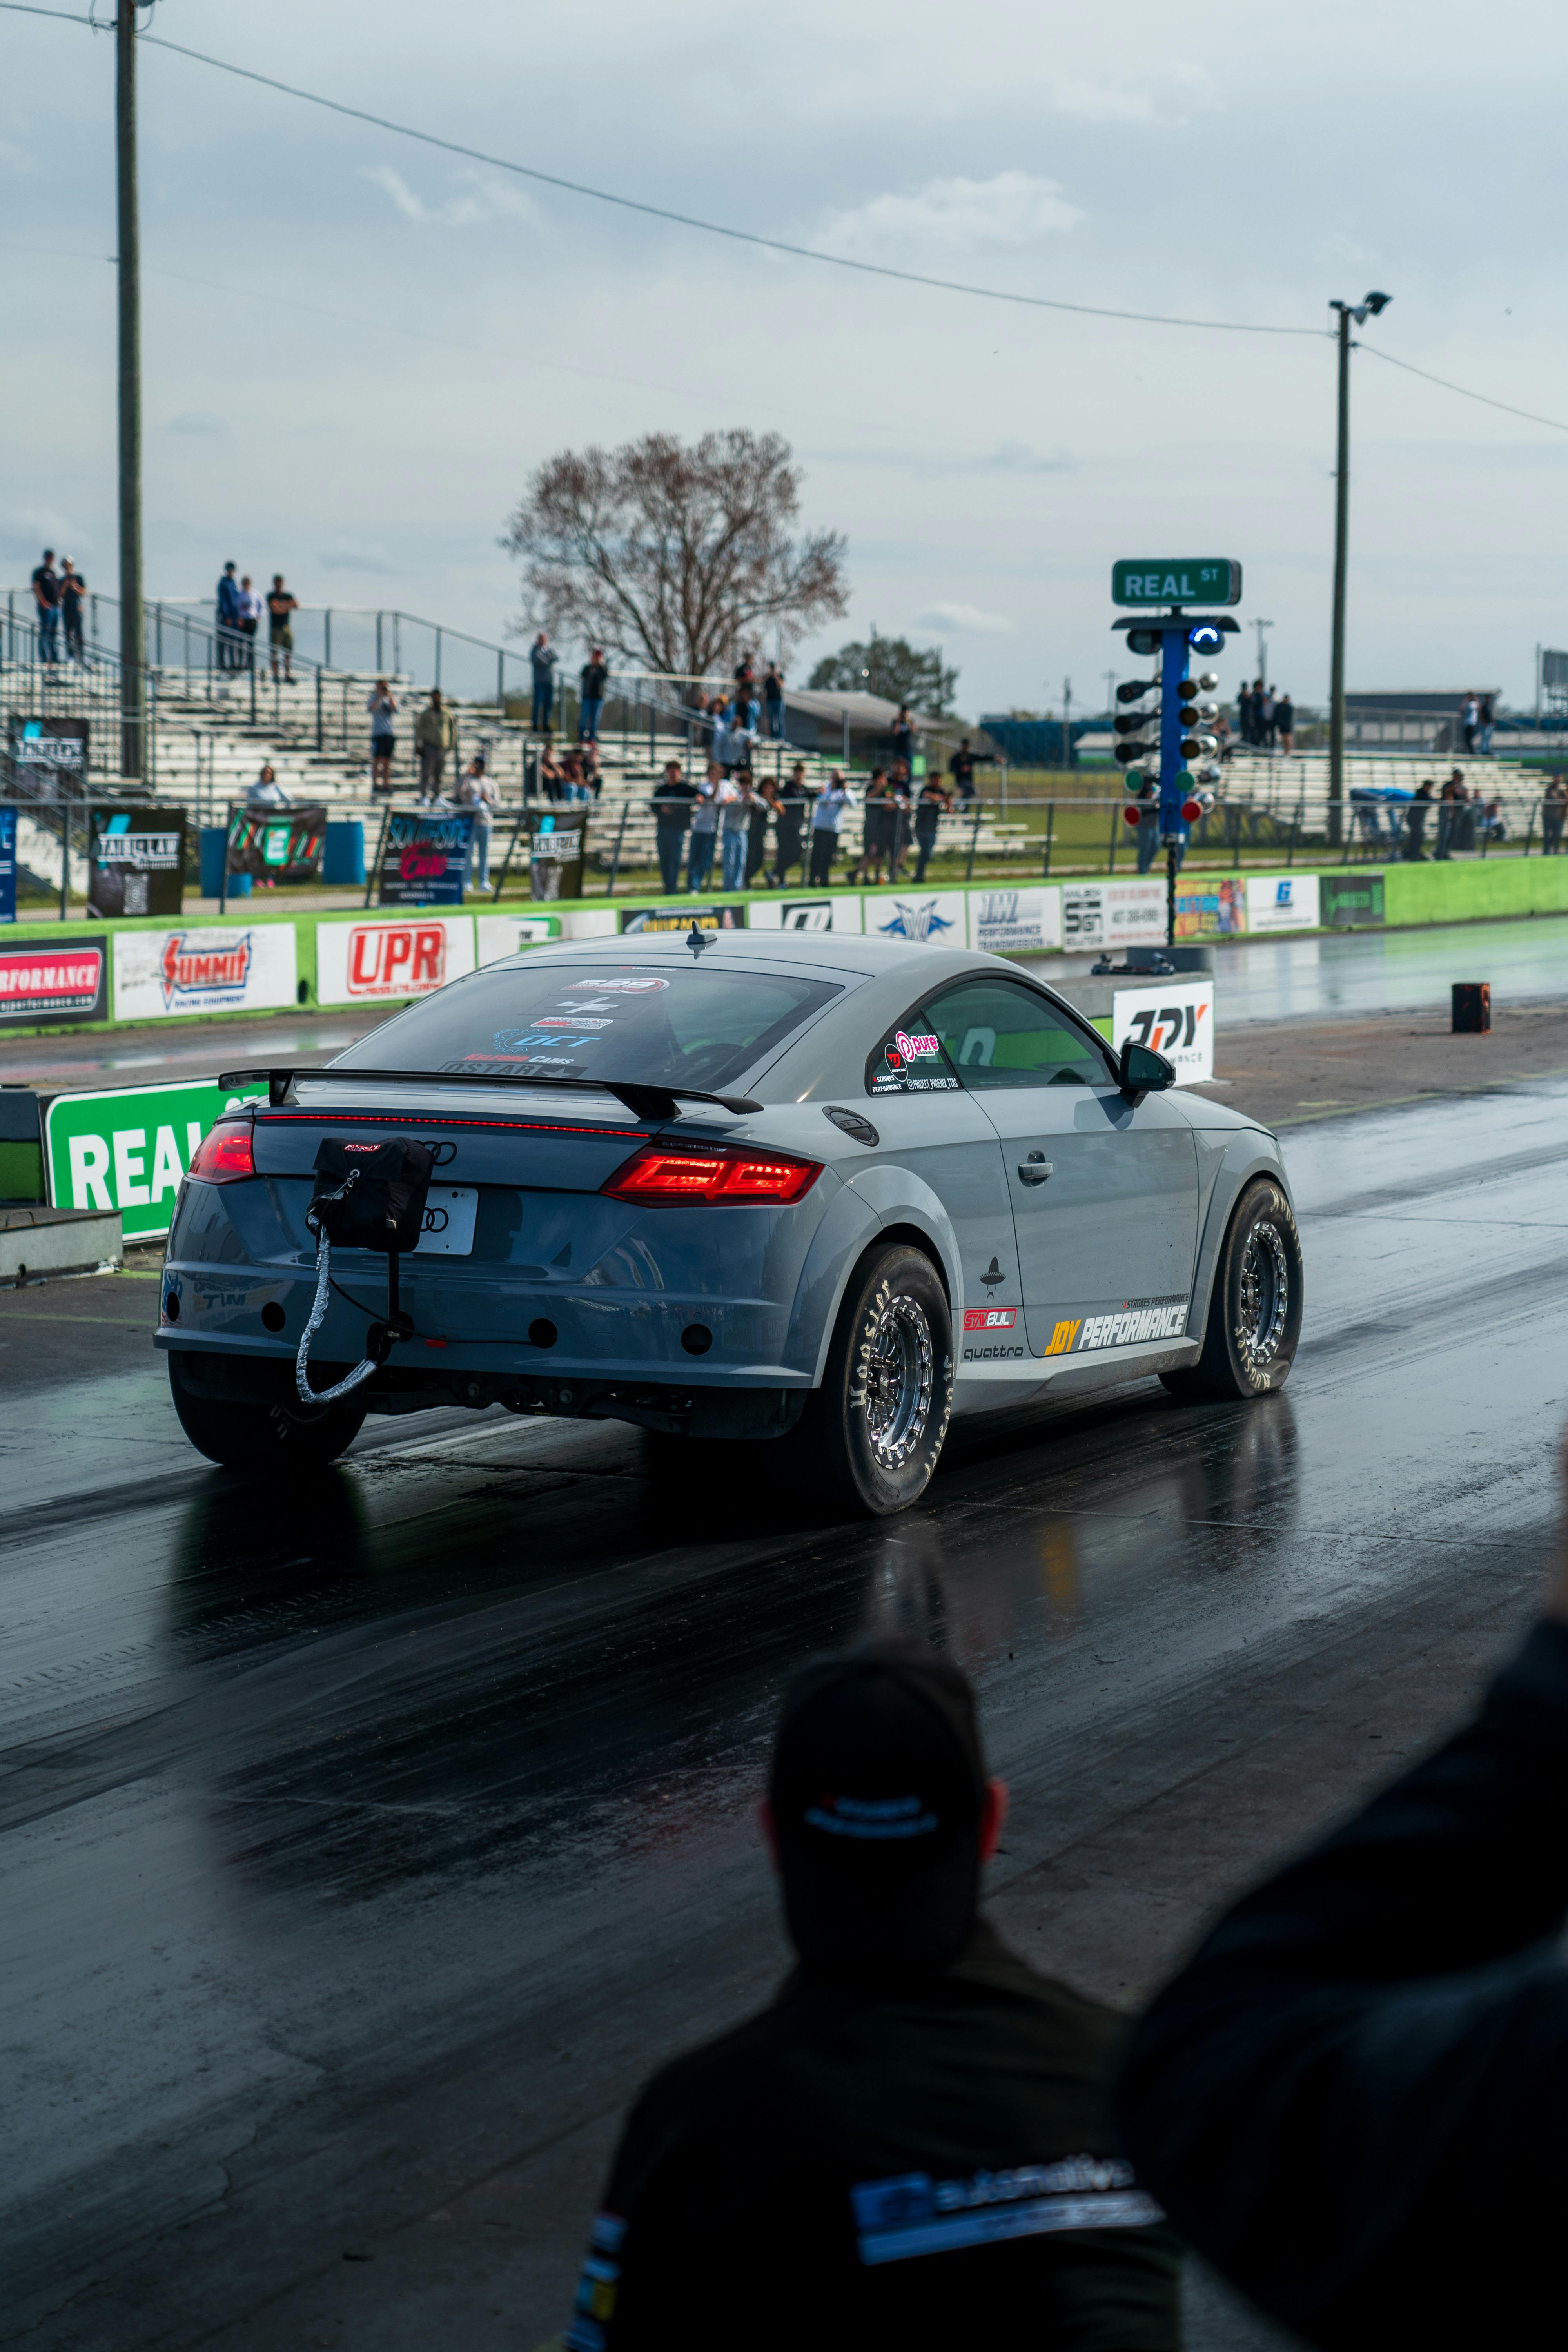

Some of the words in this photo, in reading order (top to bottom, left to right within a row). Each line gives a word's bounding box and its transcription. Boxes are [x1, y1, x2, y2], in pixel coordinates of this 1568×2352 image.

[1125, 575, 1195, 597] REAL
[1200, 568, 1218, 581] ST
[978, 924, 1041, 937] PERFORMANCE
[354, 931, 441, 984] UPR
[1120, 1004, 1209, 1054] JDY
[513, 1035, 601, 1047] DCT
[912, 1036, 938, 1054] pure
[462, 1053, 530, 1062] KELFORD
[872, 1084, 902, 1093] PERFORMANCE
[1151, 1293, 1189, 1306] PERFORMANCE
[1078, 1304, 1189, 1350] PERFORMANCE
[1044, 1319, 1082, 1356] JDY
[964, 1345, 1024, 1362] quattro
